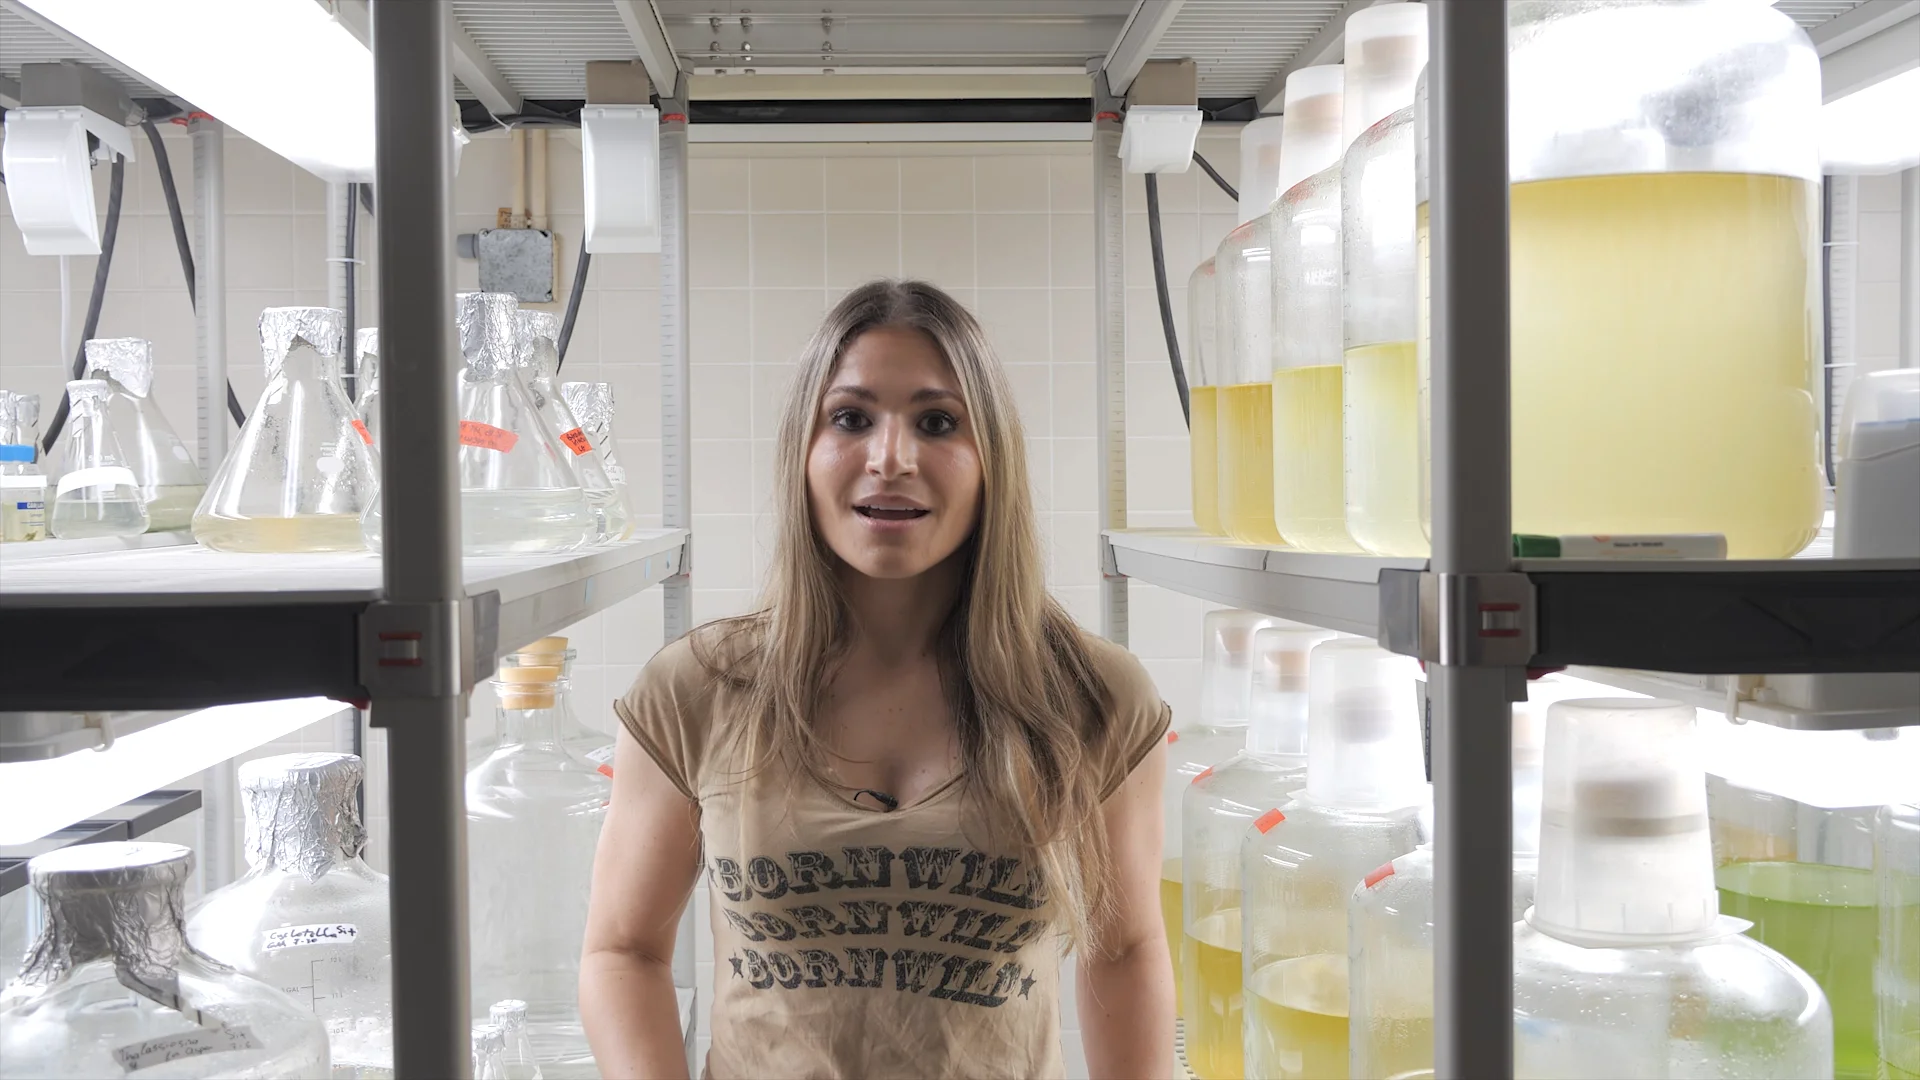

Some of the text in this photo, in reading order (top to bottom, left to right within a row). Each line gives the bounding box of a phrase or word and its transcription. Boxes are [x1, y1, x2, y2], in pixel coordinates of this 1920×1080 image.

[715, 846, 895, 901] BORN
[722, 901, 893, 942] BORN
[741, 946, 1023, 1008] BORN WILD
